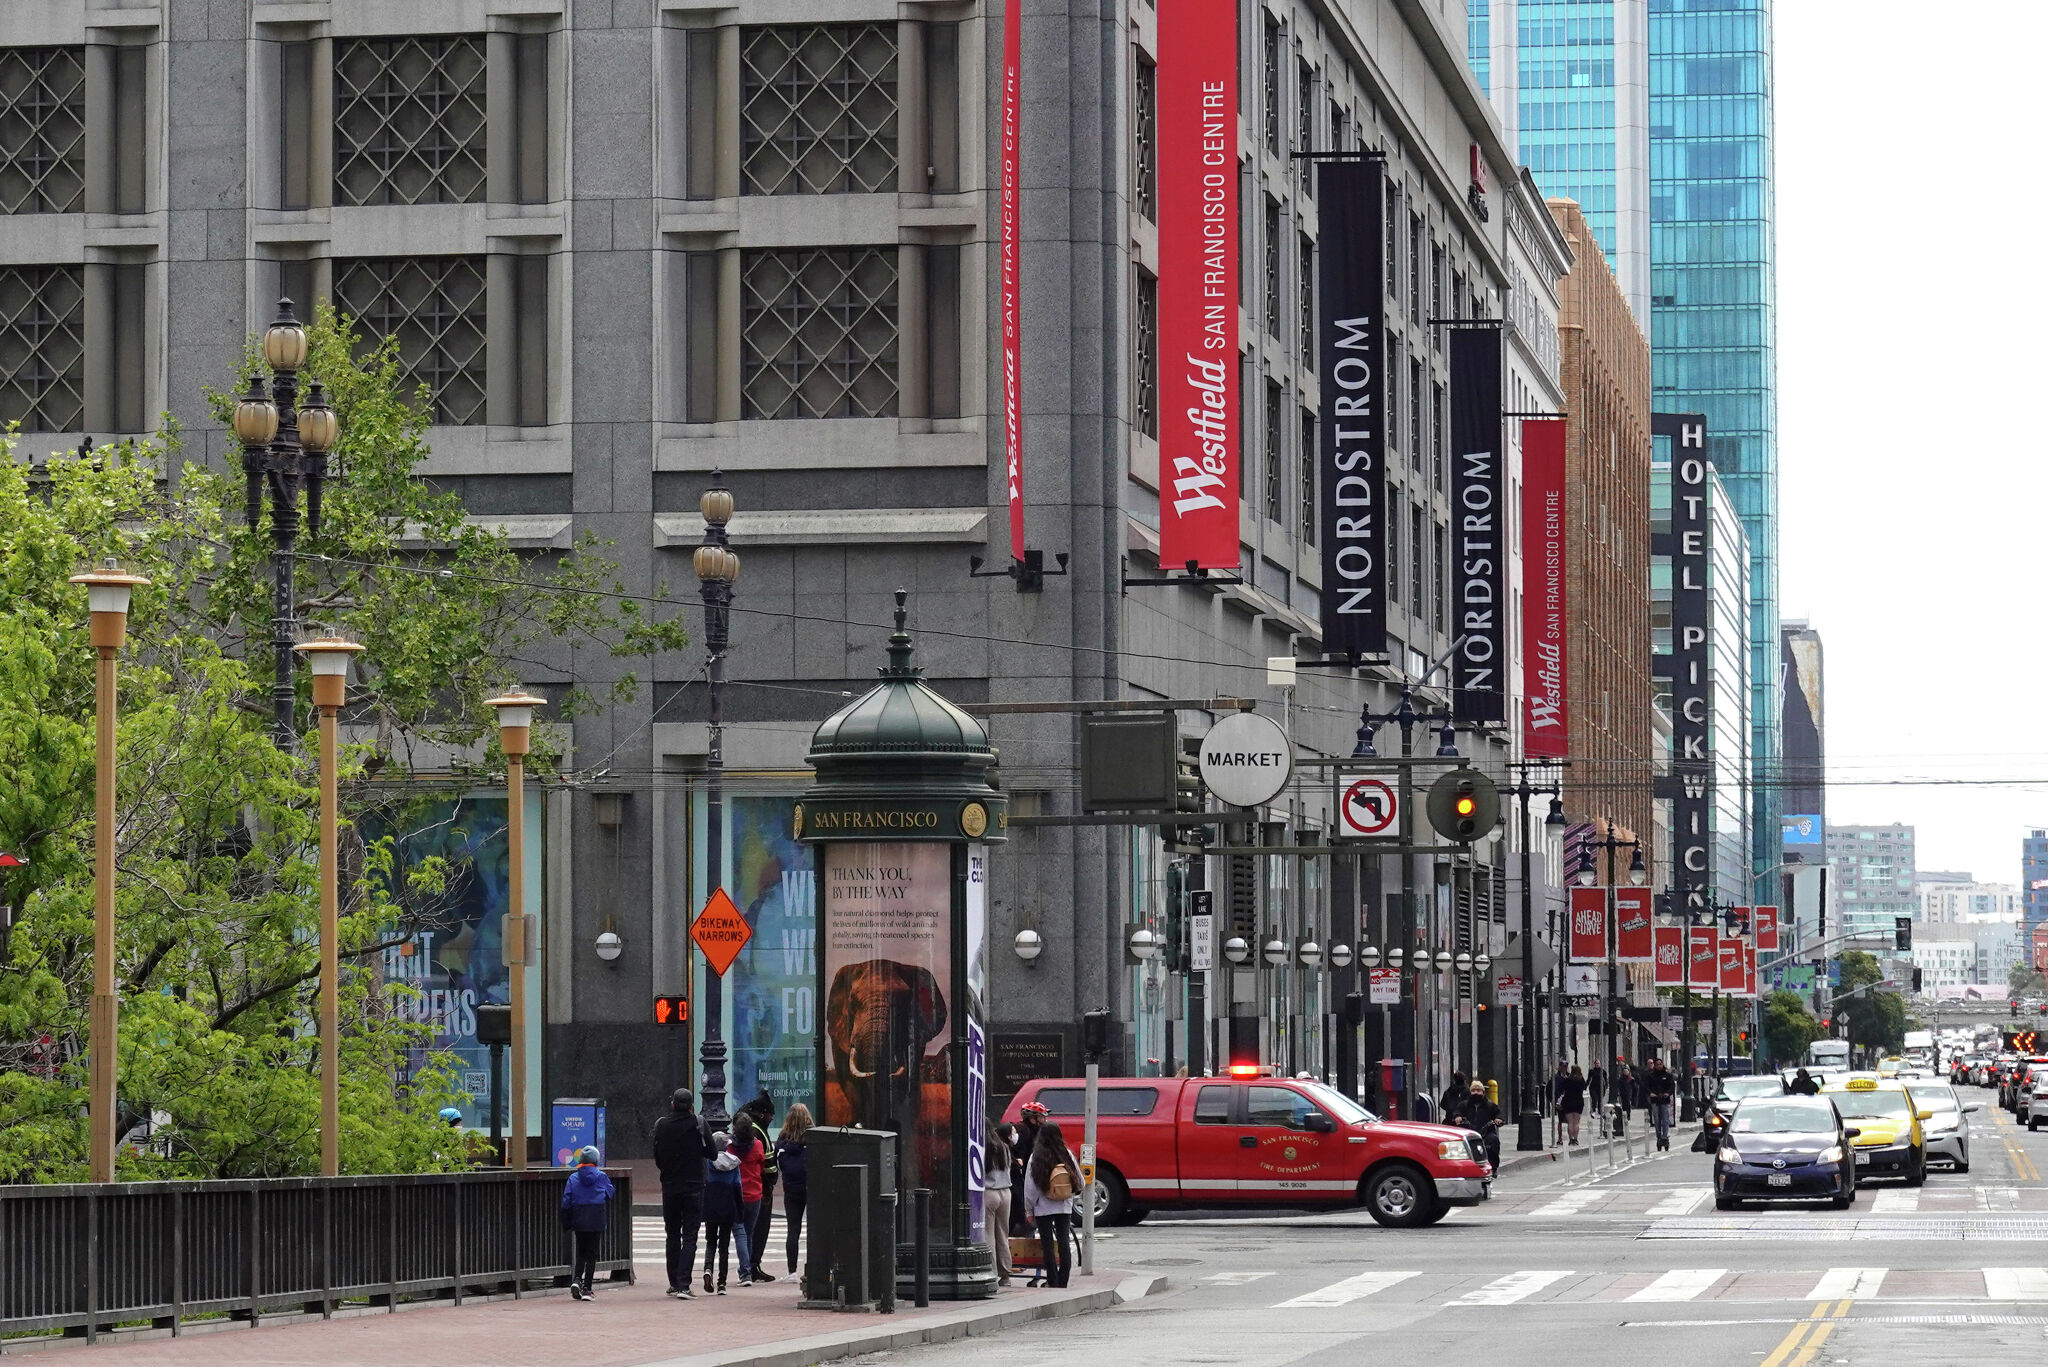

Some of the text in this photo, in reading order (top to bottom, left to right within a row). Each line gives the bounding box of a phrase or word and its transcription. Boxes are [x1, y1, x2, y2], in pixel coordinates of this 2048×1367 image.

[1005, 65, 1015, 151] CENTRE
[1004, 155, 1013, 288] FRANCISCO
[1174, 80, 1227, 519] Westfield SAN FRANCISCO CENTRE
[1005, 295, 1013, 338] SAN
[1333, 315, 1372, 616] NORDSTROM
[1462, 451, 1494, 693] NORDSTROM
[1531, 490, 1560, 733] Westfield SAN FRANCISCO CENTRE
[1681, 423, 1706, 907] HOTEL PICKWICK
[1207, 752, 1282, 767] MARKET
[815, 811, 938, 828] SAN FRANCISCO
[832, 867, 912, 882] THANK YOU,
[832, 886, 907, 899] BY THE WAY
[701, 918, 742, 930] BIKEWAY
[1575, 922, 1602, 935] CURVE
[700, 931, 743, 942] NARROWS
[1848, 1080, 1875, 1089] YELLOW
[773, 1088, 810, 1097] ENDEAVORS
[1262, 1135, 1320, 1147] SAN FRANCISCO
[1260, 1161, 1321, 1174] FIRE DEPARTMENT
